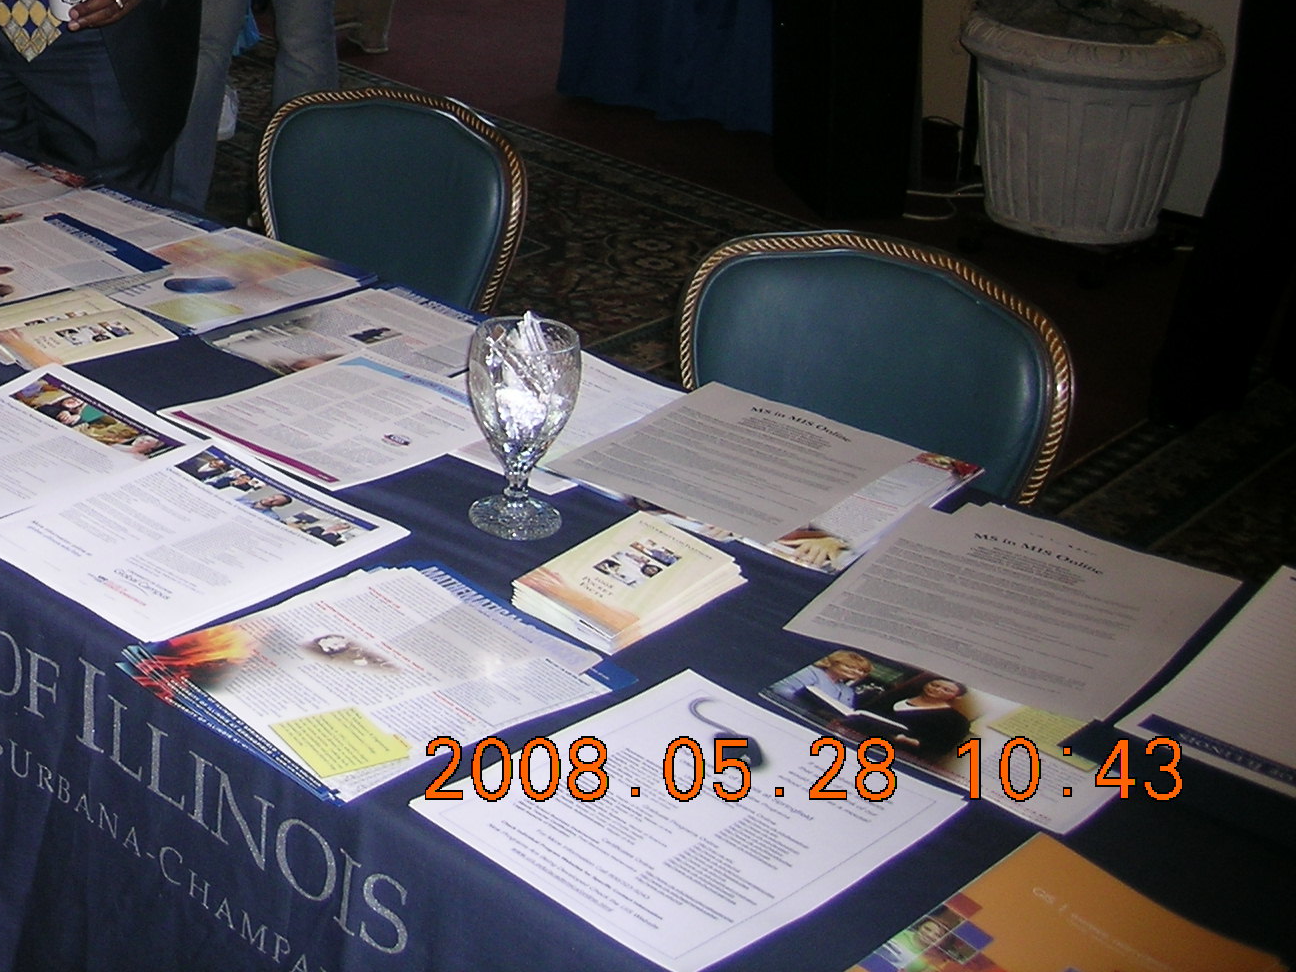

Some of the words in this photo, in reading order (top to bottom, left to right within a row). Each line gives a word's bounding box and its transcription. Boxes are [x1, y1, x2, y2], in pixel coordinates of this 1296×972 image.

[974, 532, 999, 541] MS
[1021, 542, 1053, 557] MIS
[1055, 553, 1104, 576] Online
[8, 739, 330, 972] URBANA-CHAMPA
[75, 655, 408, 955] ILLINOIS
